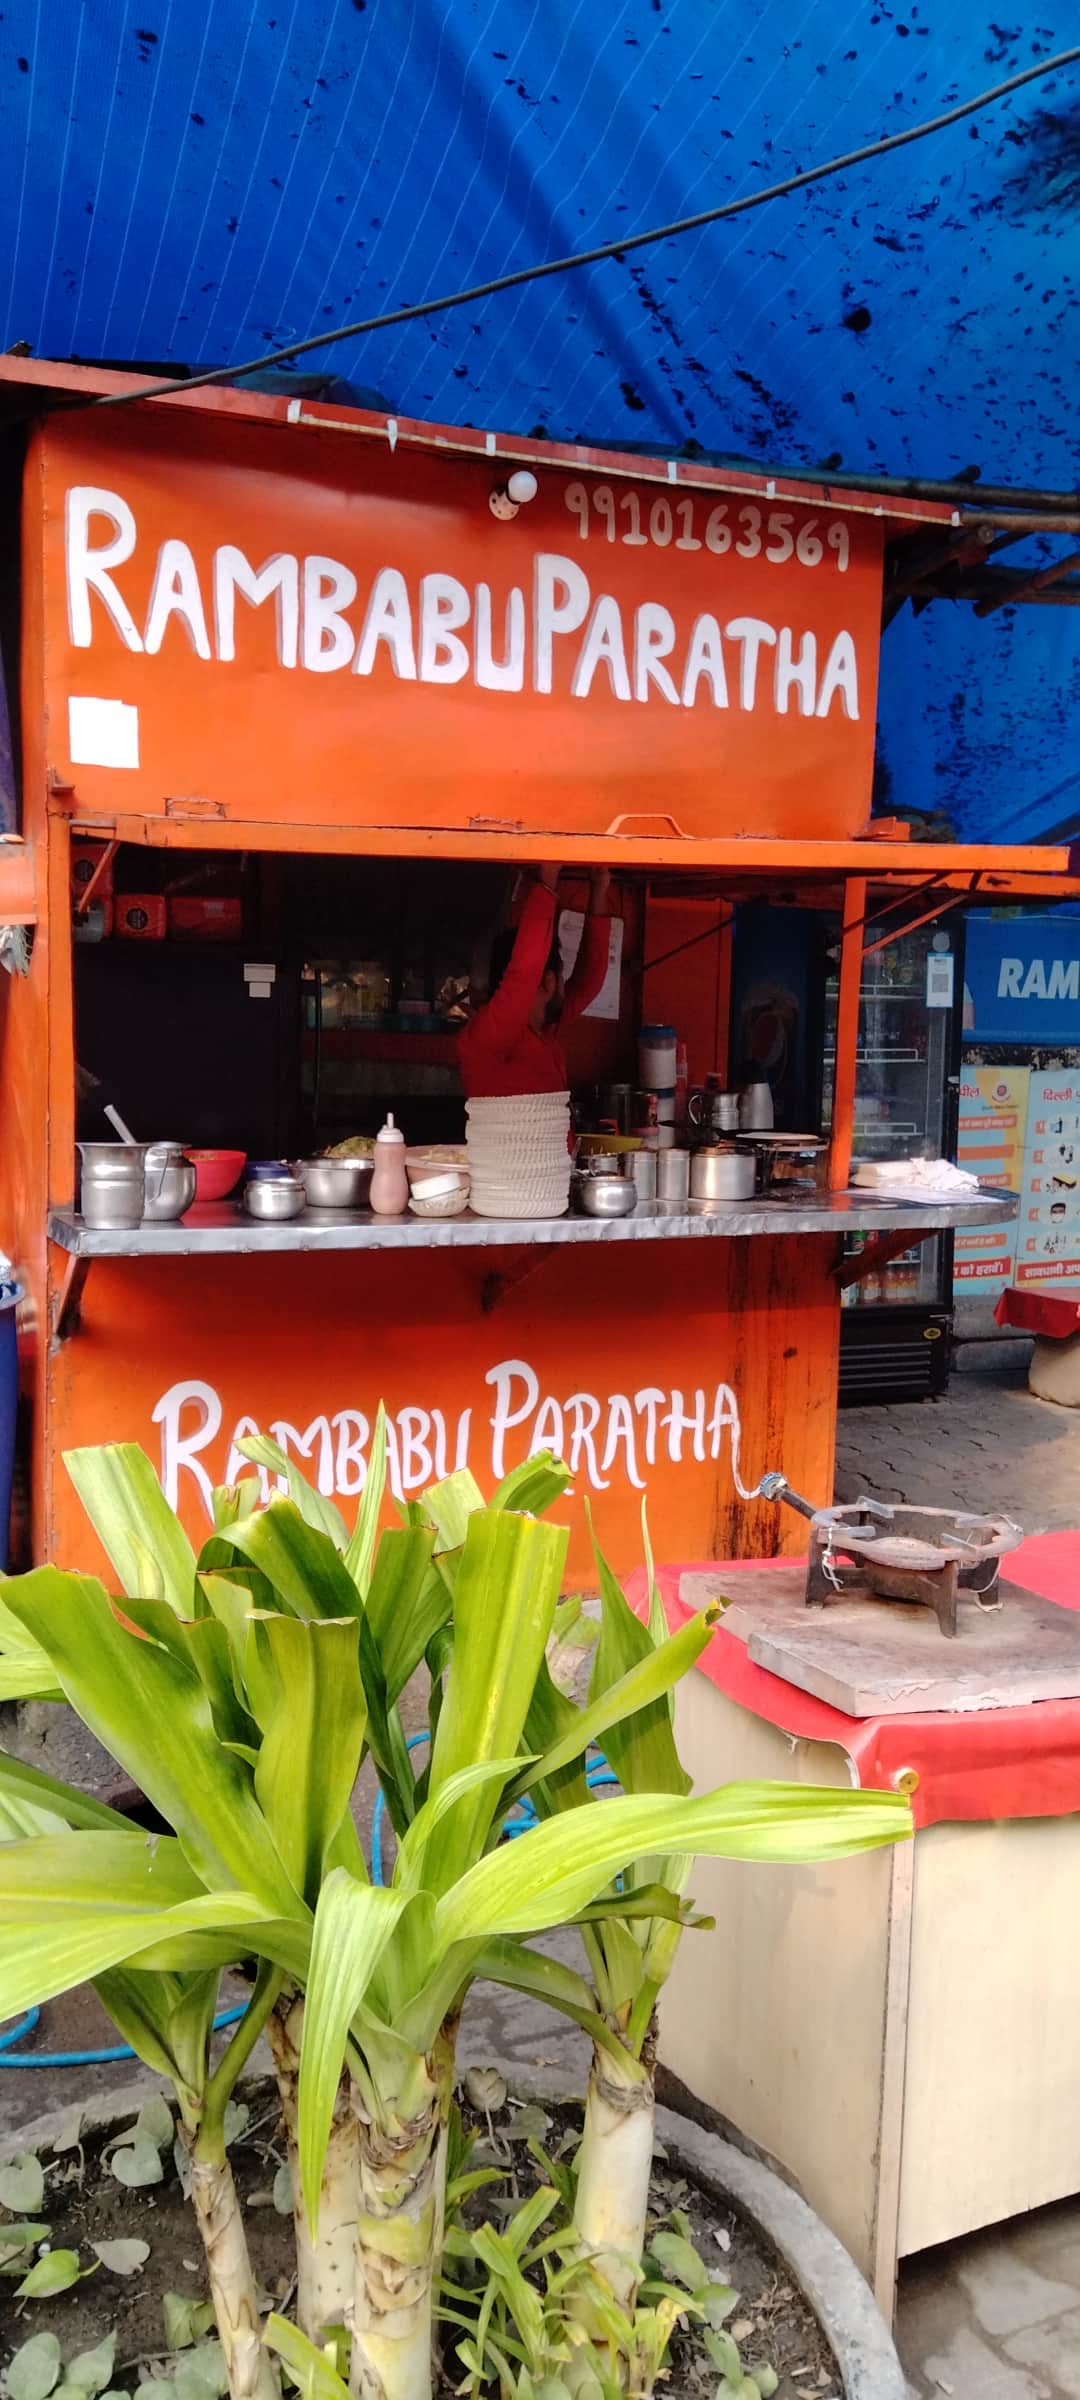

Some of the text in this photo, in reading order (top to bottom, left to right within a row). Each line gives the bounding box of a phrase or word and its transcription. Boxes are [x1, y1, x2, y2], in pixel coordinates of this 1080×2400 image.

[564, 482, 849, 572] 9910163569
[65, 485, 860, 721] RAMBABU PARATHA
[997, 957, 1079, 1000] RAM
[151, 1359, 757, 1525] RAMBABU PARATHA
